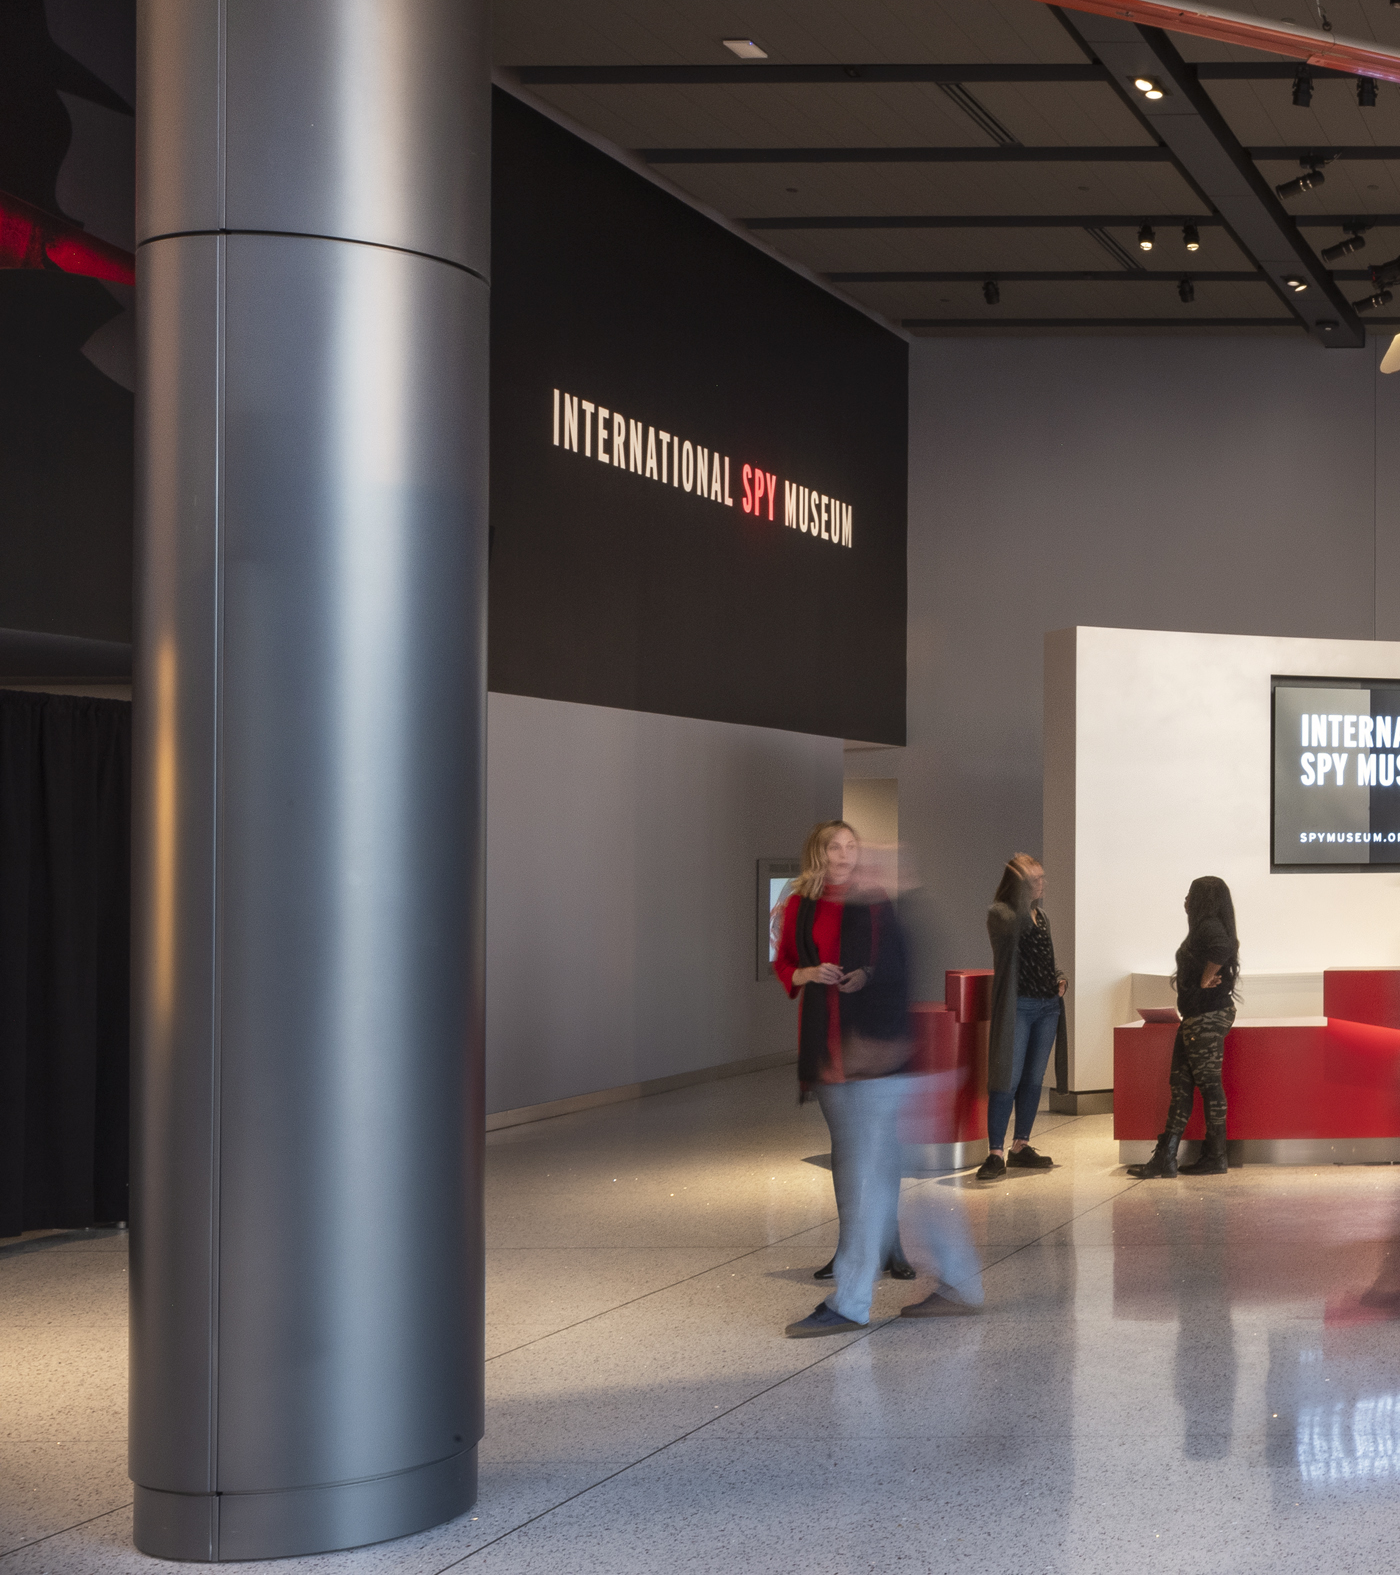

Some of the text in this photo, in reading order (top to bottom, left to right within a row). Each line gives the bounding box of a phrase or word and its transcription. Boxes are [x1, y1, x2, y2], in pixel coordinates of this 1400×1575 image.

[553, 388, 852, 548] INTERNATIONAL SPY MUSEUM
[1300, 751, 1349, 786] SPY
